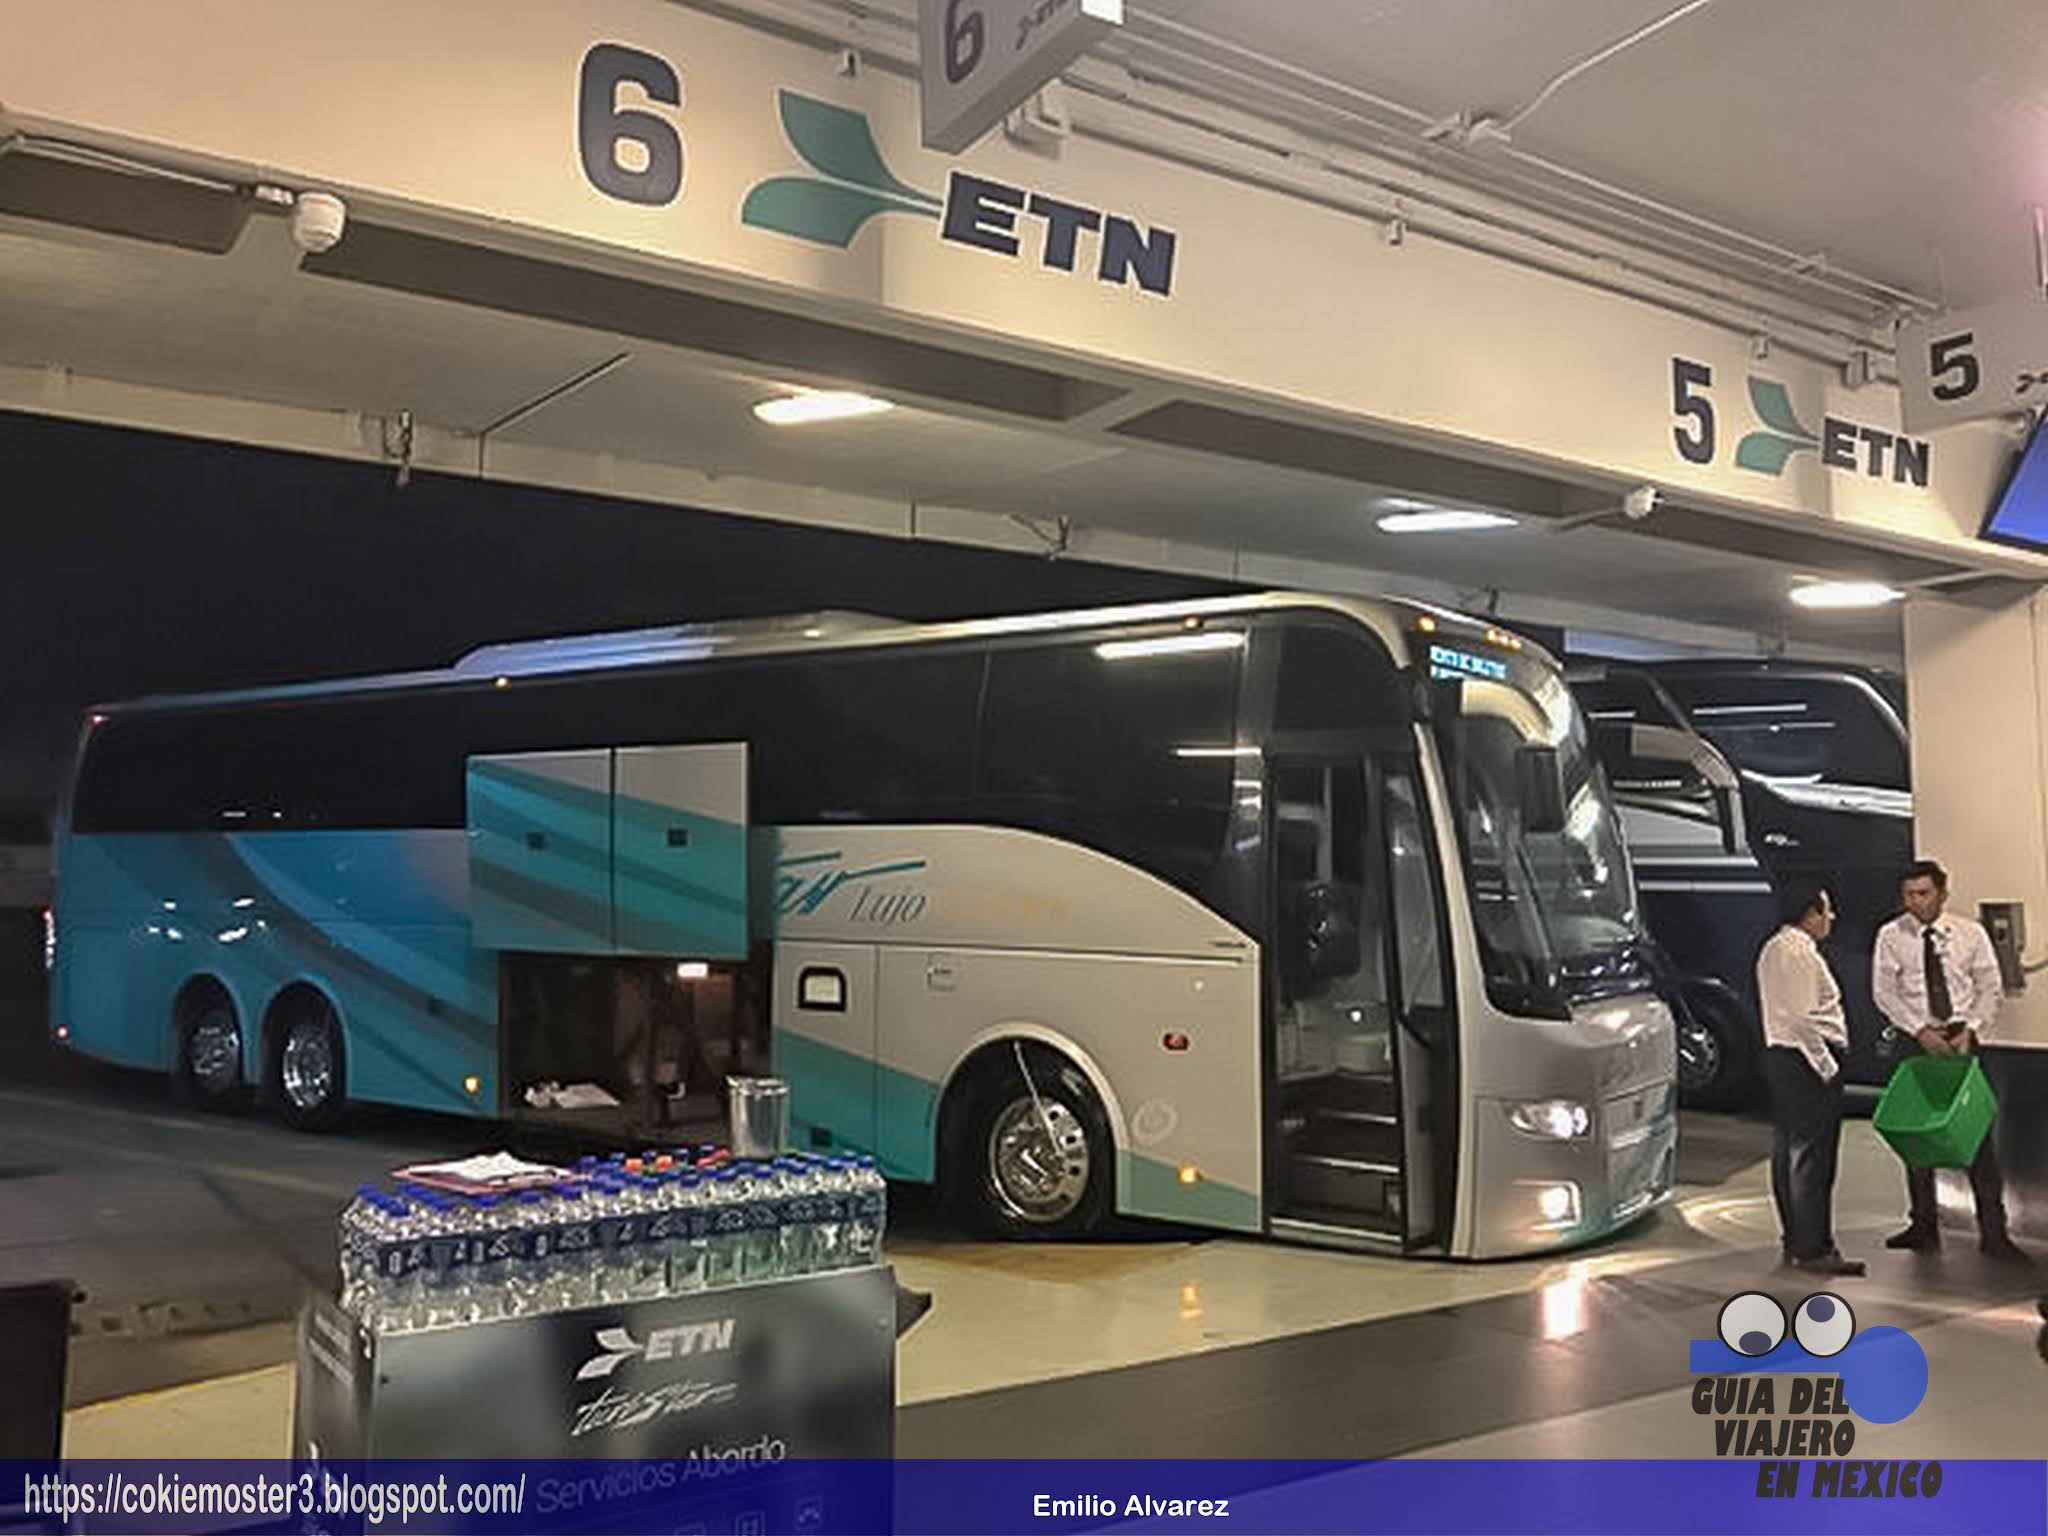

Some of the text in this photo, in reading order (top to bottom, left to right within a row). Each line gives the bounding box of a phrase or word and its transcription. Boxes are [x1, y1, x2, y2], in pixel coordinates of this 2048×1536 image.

[945, 0, 984, 83] 6
[579, 43, 684, 207] 6
[941, 171, 1177, 296] ETN
[1930, 332, 1980, 400] 5
[1672, 356, 1716, 465] 5
[1822, 416, 1930, 487] ETN
[644, 1318, 737, 1361] ETN
[535, 1433, 787, 1513] Servicios Abordo
